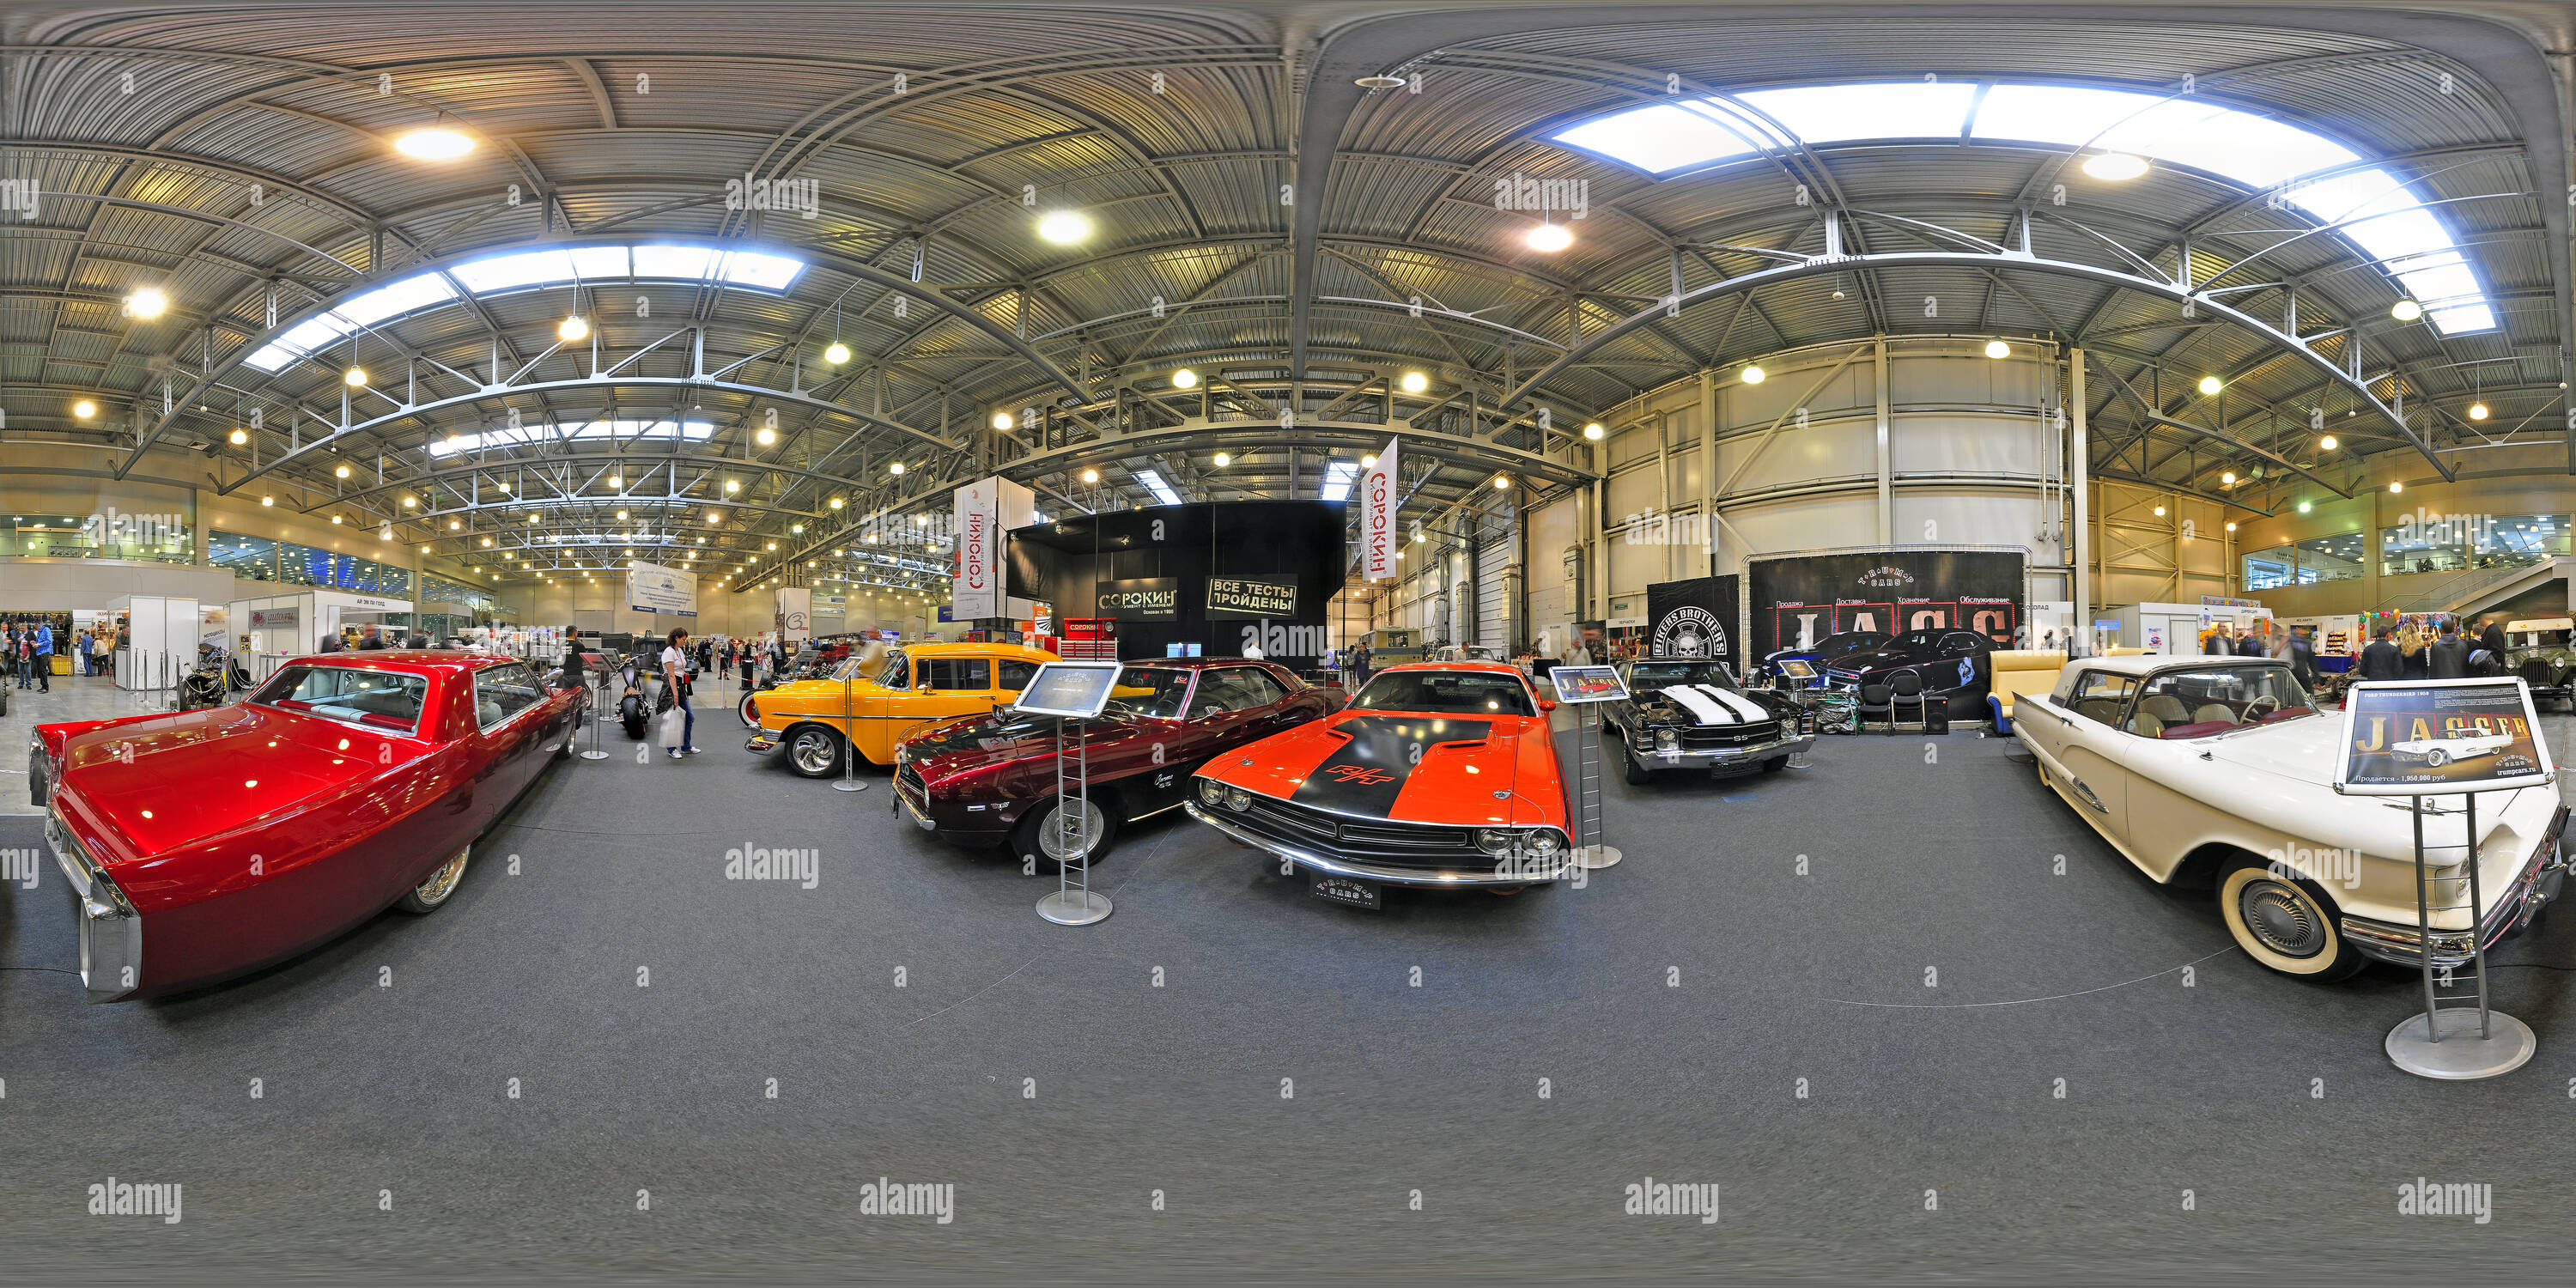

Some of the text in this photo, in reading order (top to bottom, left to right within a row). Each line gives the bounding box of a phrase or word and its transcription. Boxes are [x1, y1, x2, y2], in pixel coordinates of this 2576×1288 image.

[1370, 472, 1387, 572] СОРОКИН
[969, 513, 984, 589] СОРОКИН
[1857, 566, 1915, 586] TRUMP
[1870, 579, 1901, 587] CARS
[1213, 580, 1294, 598] ВСЕ ТЕСТЫ
[1098, 590, 1175, 610] СОРОКИН
[1212, 592, 1293, 611] ПРОЙДЕНЫ
[1776, 600, 1804, 609] Продажа
[1836, 598, 1867, 606] Доставка
[1959, 595, 2009, 605] Обслуживание
[1655, 612, 1679, 653] BIKERS
[1679, 608, 1725, 653] BROTHERS
[1326, 764, 1395, 785] R/T
[2354, 775, 2395, 783] Продается
[2432, 774, 2446, 783] руб
[2496, 766, 2537, 776] trumpcars.ru
[1315, 878, 1373, 899] TRUMP
[1329, 887, 1359, 899] CARS
